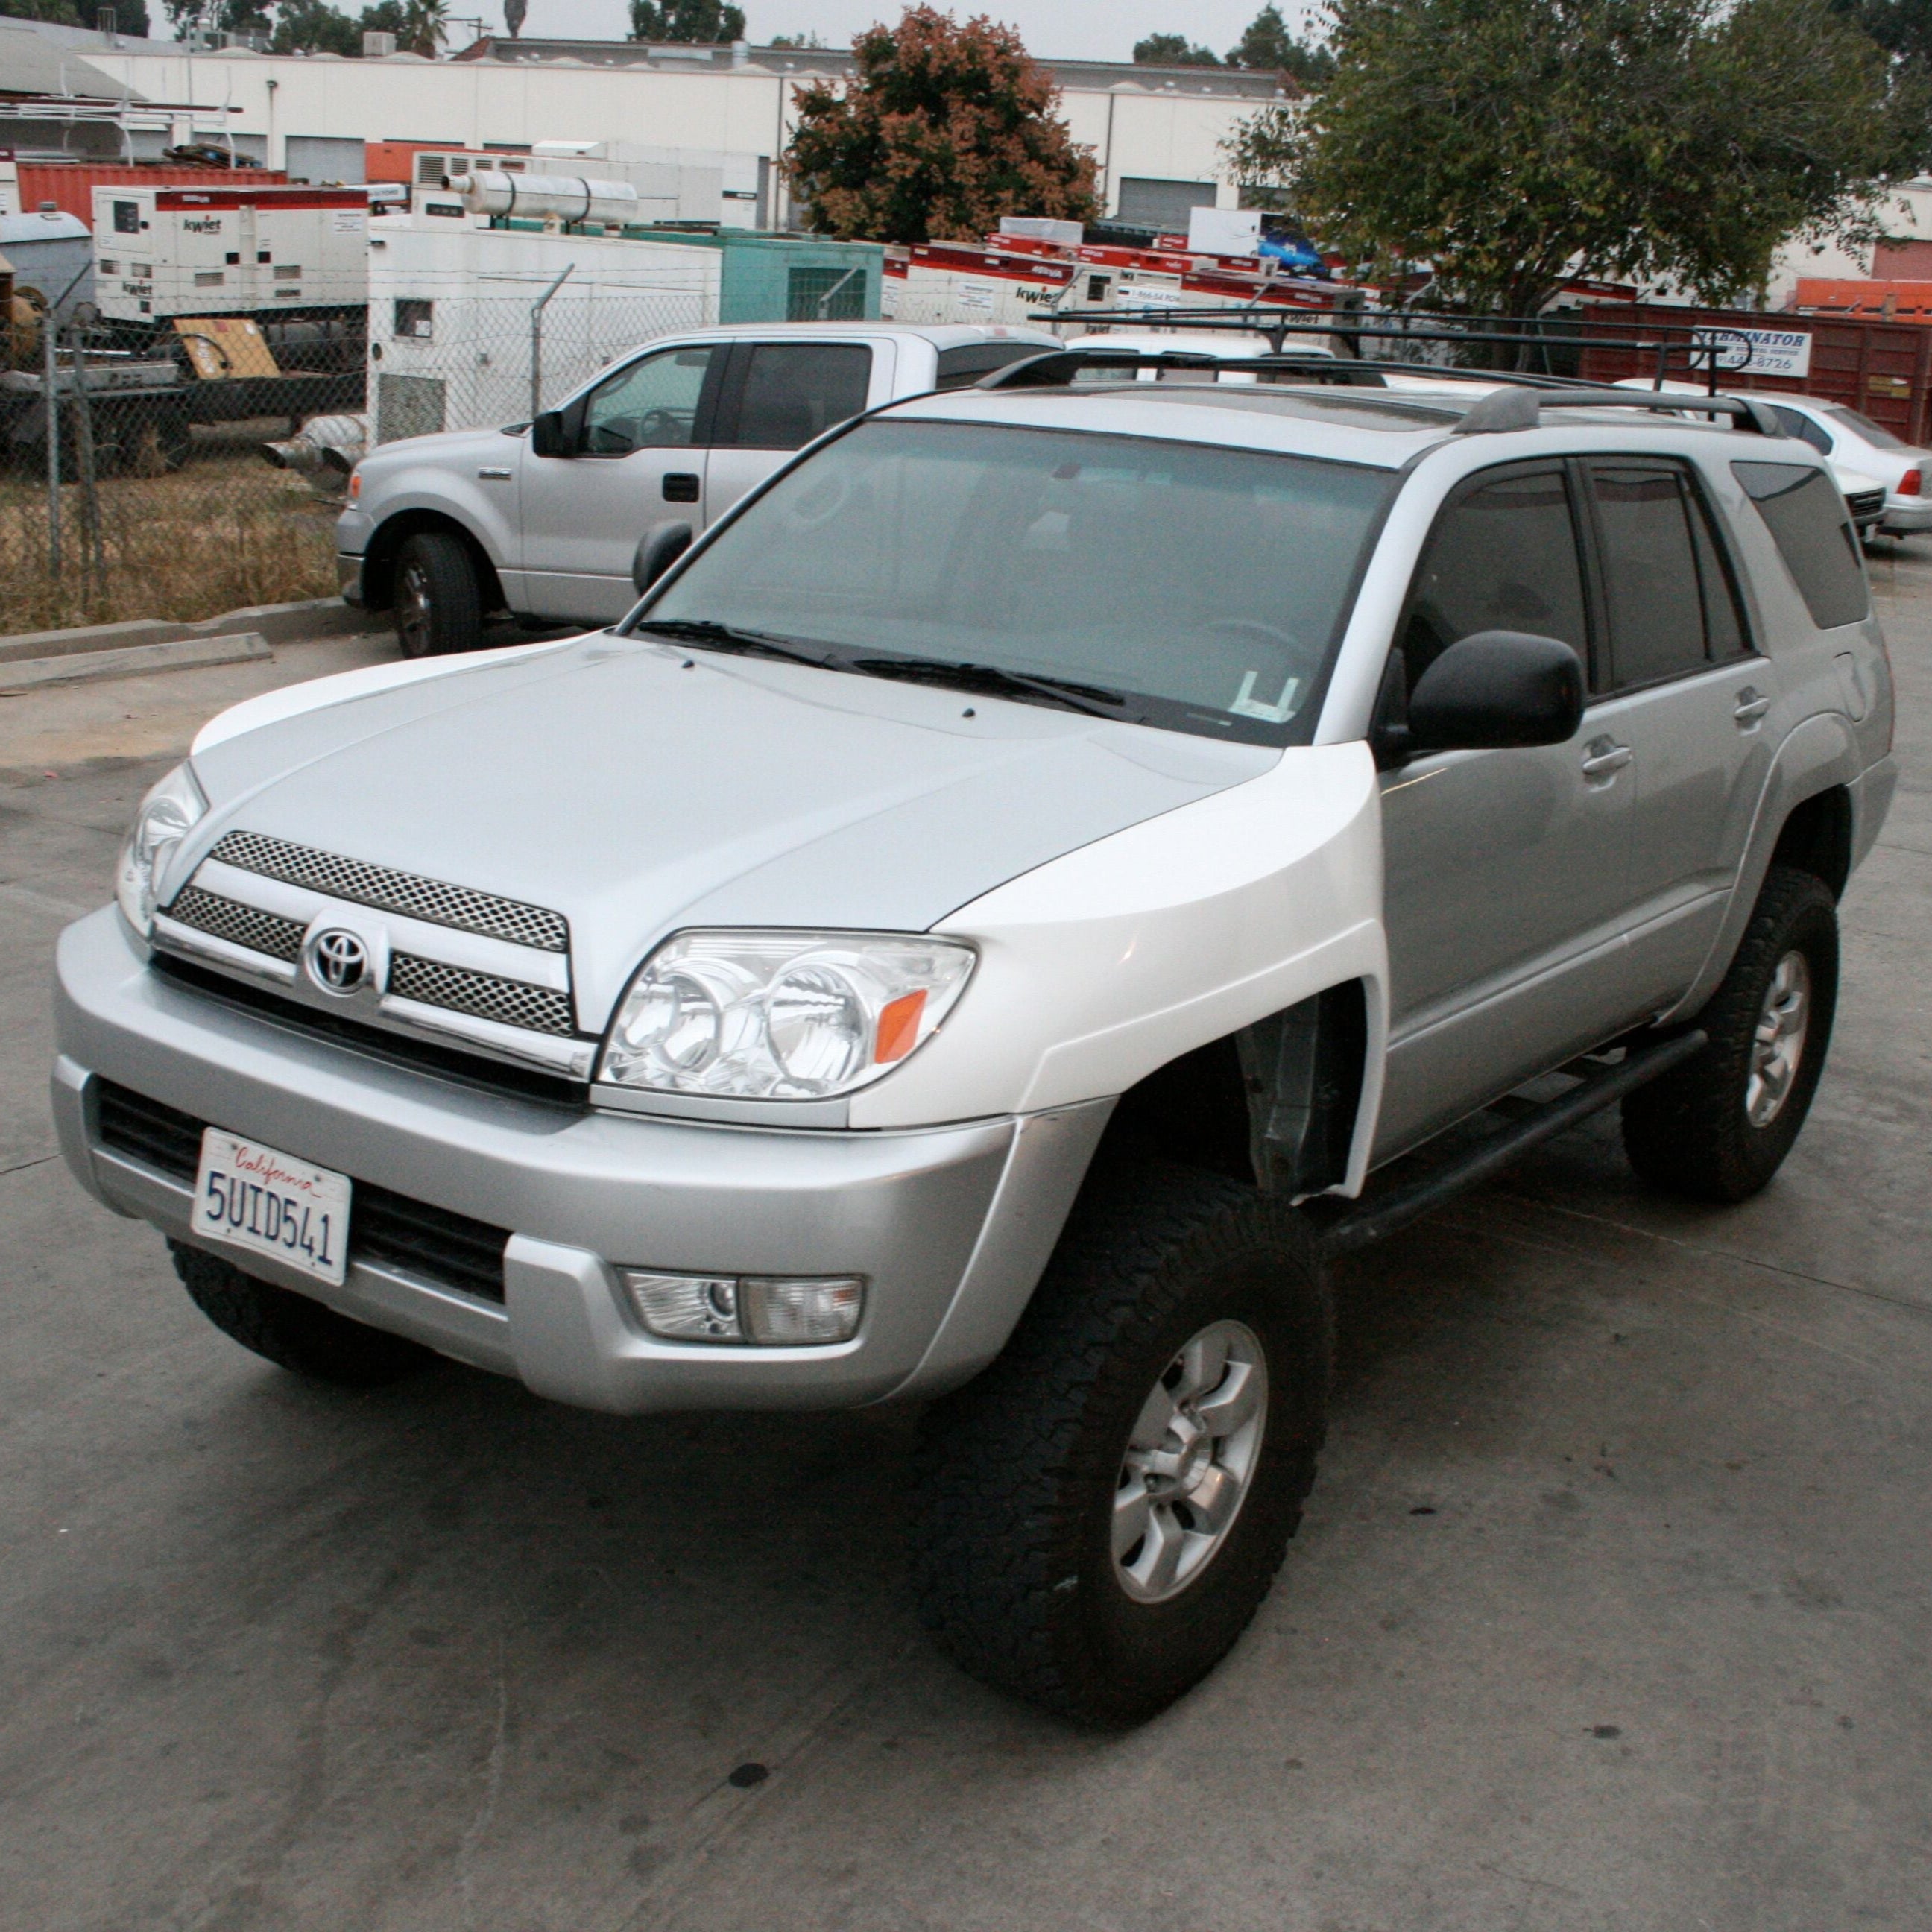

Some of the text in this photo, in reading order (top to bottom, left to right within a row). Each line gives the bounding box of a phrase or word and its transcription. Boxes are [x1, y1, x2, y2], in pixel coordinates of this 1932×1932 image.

[1697, 329, 1805, 347] RMNATOR
[236, 1146, 323, 1198] California
[206, 1170, 333, 1266] 5UID541
